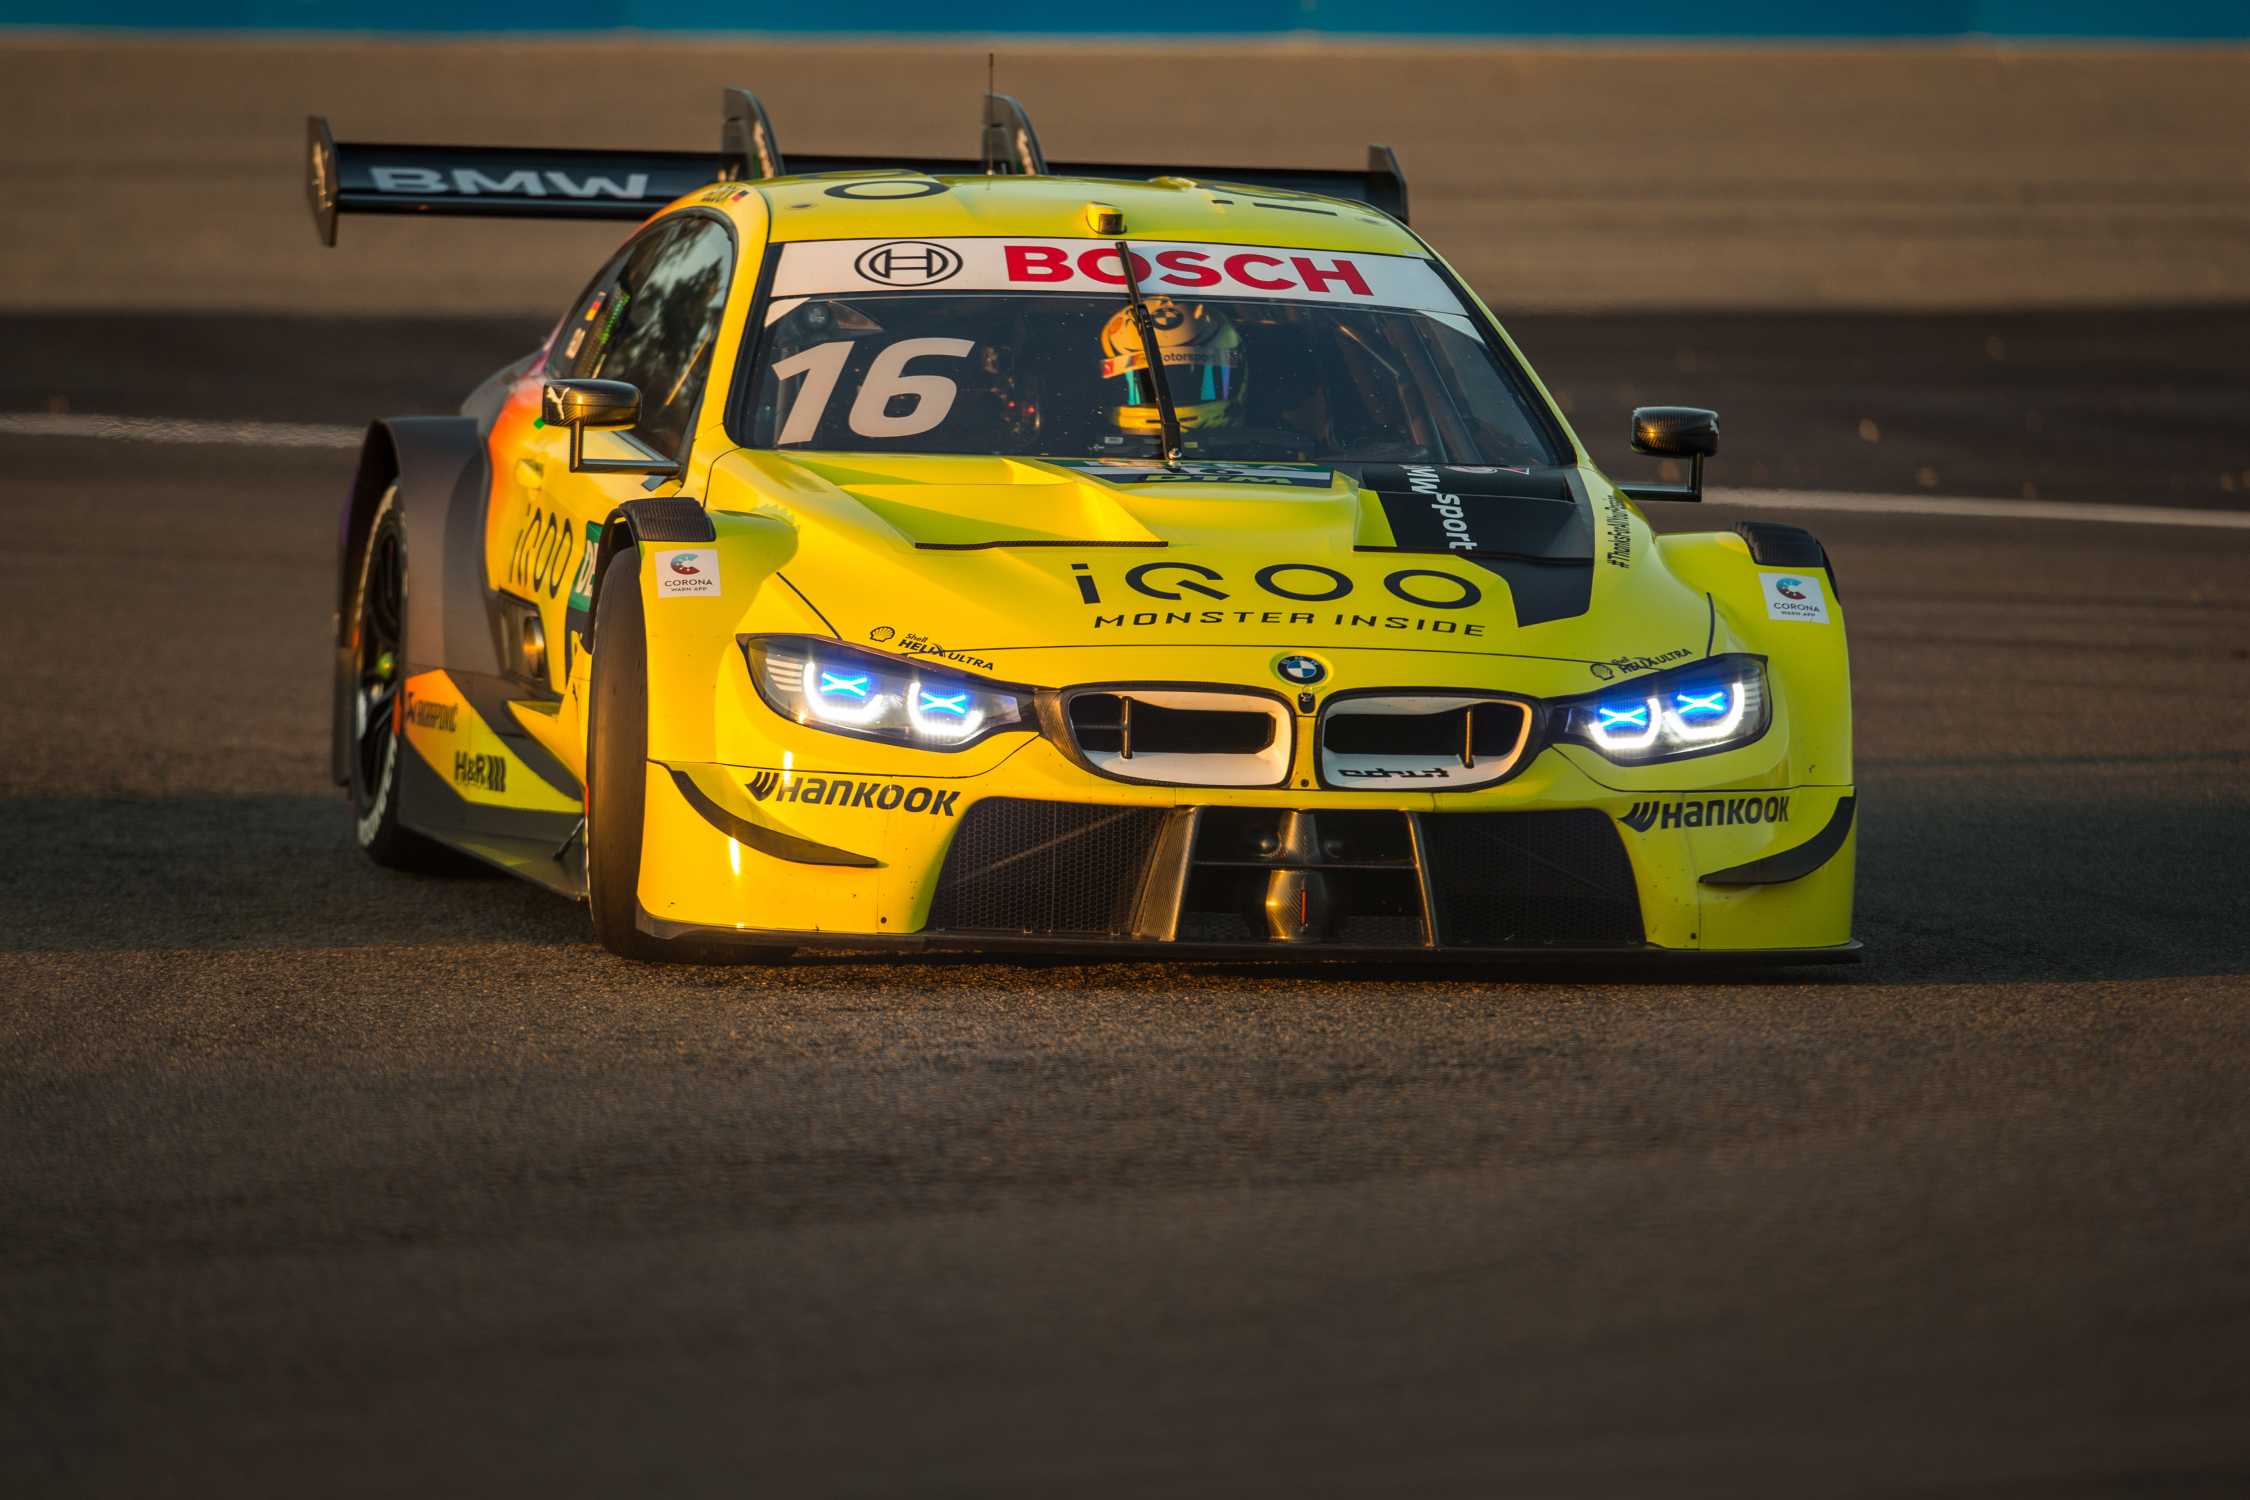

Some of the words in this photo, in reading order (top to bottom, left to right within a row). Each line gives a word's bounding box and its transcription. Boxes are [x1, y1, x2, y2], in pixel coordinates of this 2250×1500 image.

[370, 167, 649, 199] BMW
[1004, 245, 1374, 296] BOSCH
[771, 337, 976, 445] 16
[664, 579, 713, 587] CORONA
[1773, 602, 1820, 612] CORONA
[1094, 611, 1315, 628] MONSTER
[1335, 614, 1486, 637] INSIDE
[905, 633, 928, 643] Shell
[898, 639, 946, 658] HELIX
[948, 652, 993, 670] ULTRA
[1657, 648, 1692, 664] ULTRA
